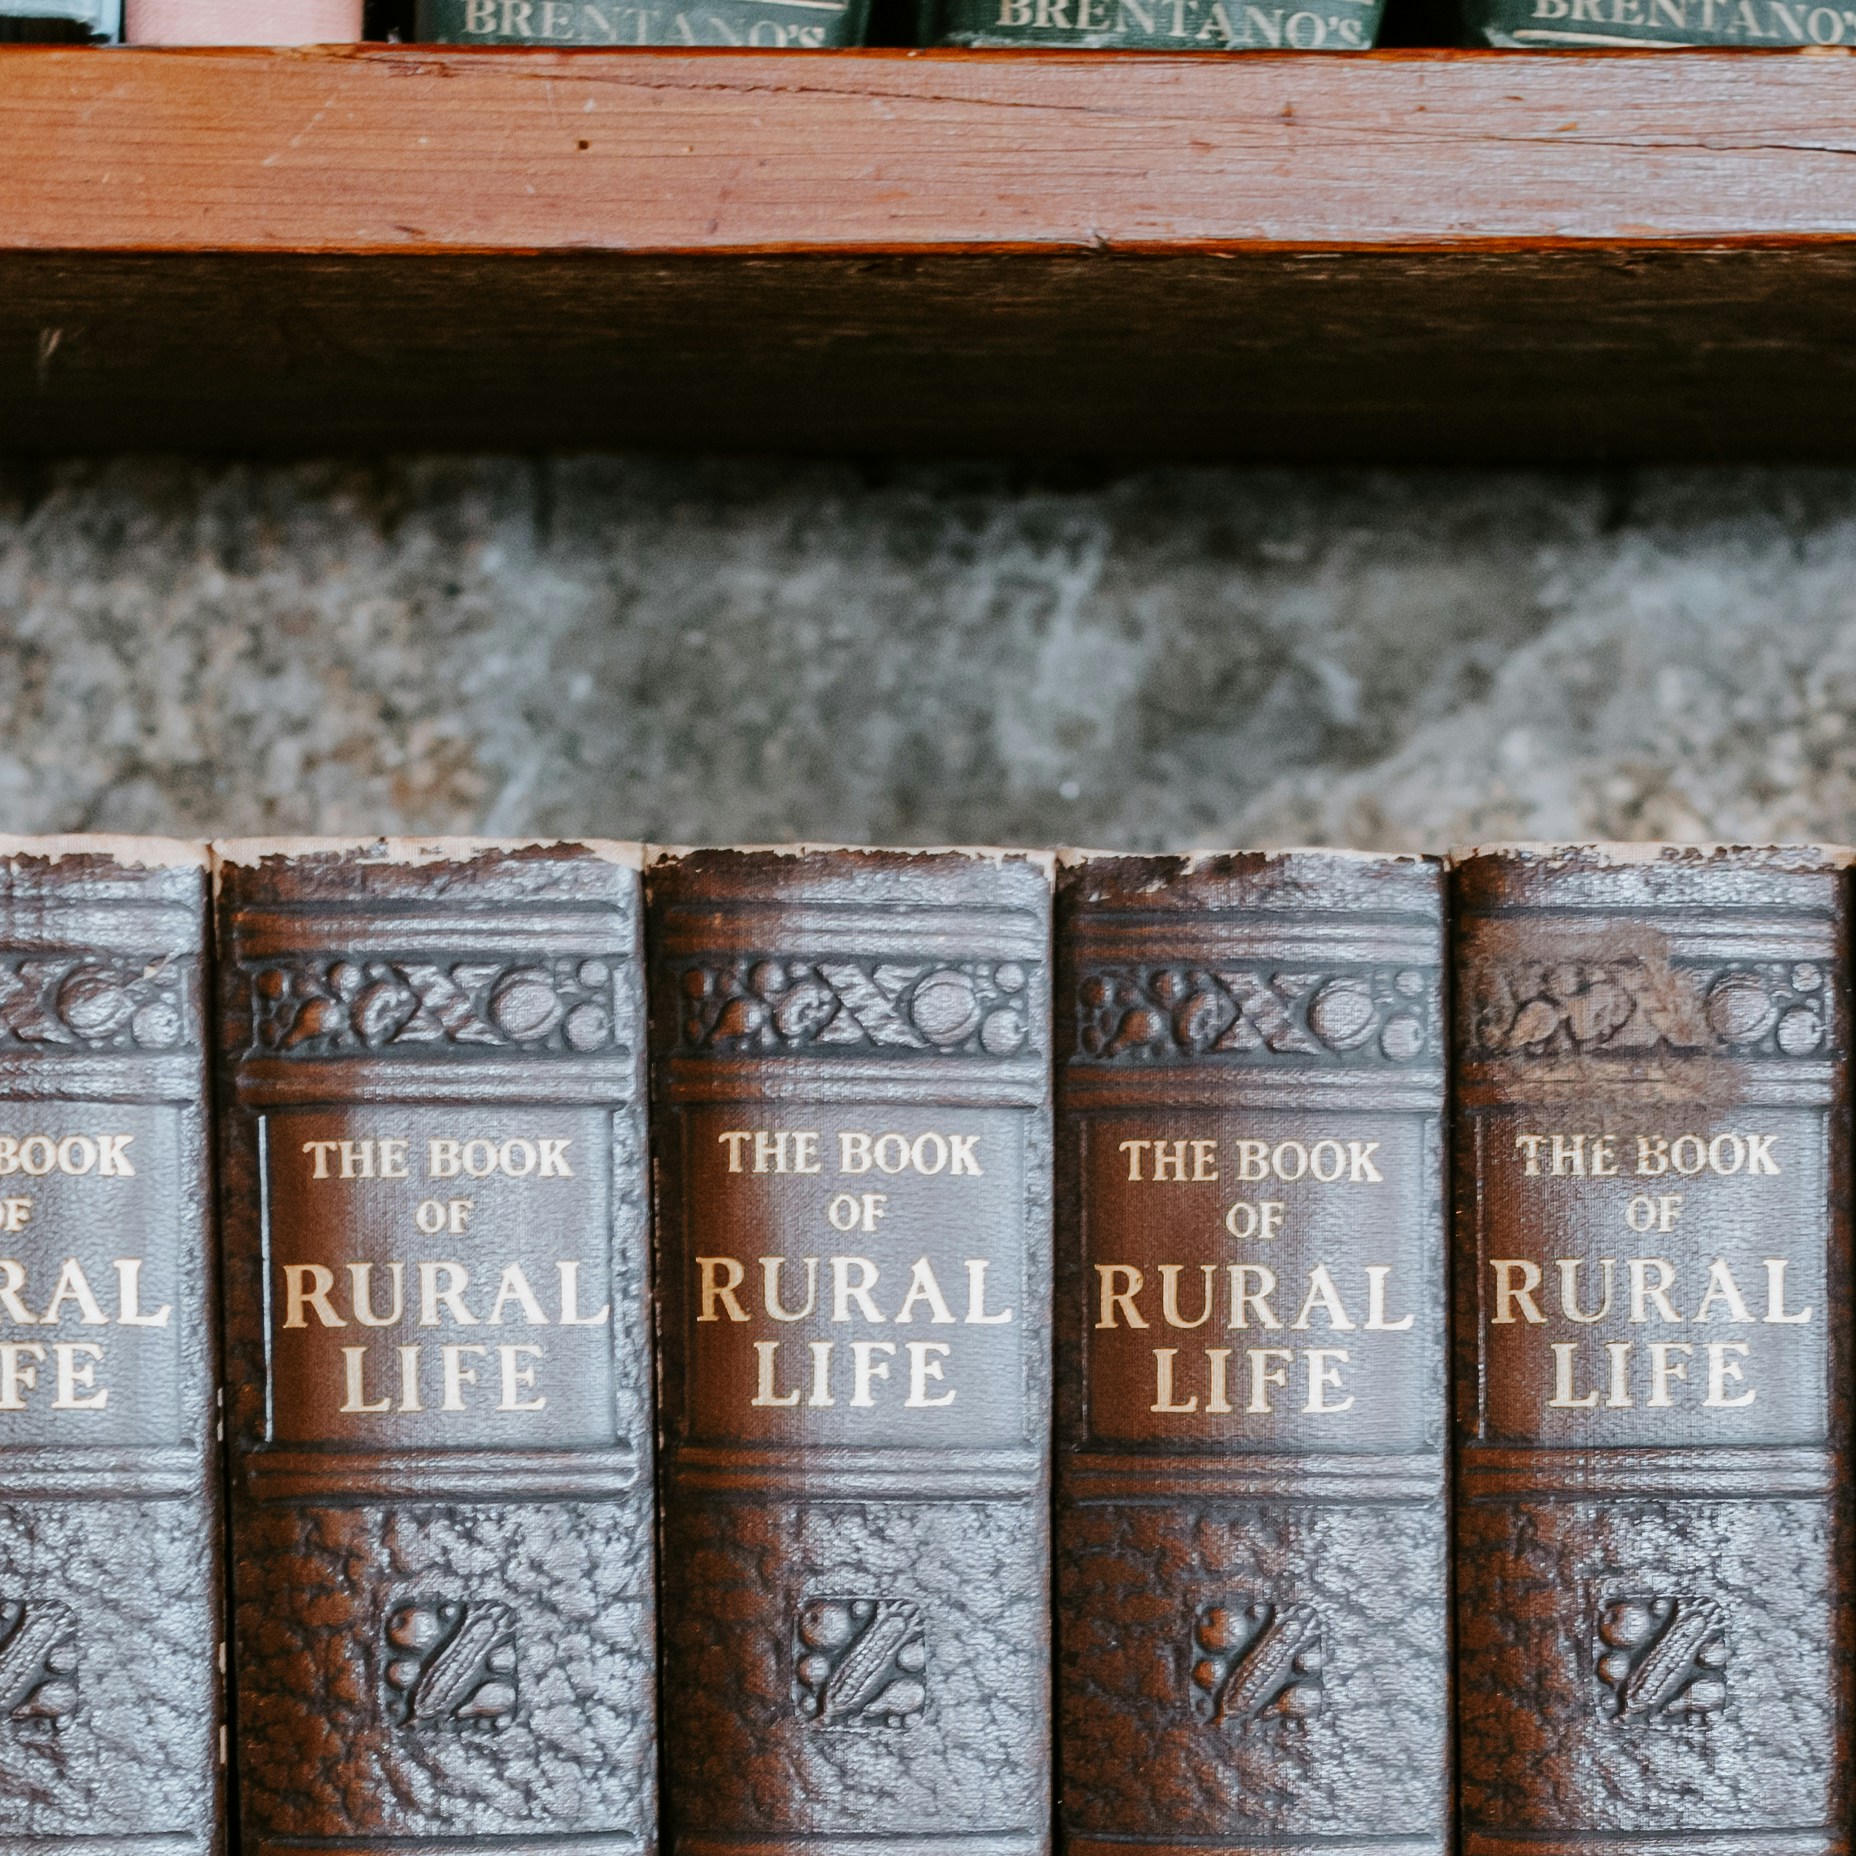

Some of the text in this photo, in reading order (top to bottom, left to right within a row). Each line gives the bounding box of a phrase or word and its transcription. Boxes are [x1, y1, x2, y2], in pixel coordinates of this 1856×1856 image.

[302, 1138, 573, 1179] THE BOOK
[718, 1131, 981, 1176] THE BOOK
[1119, 1140, 1384, 1183] THE BOOK
[1516, 1134, 1781, 1176] THE BOOK
[283, 1259, 610, 1329] RURAL
[696, 1257, 1013, 1325] RURAL
[1094, 1264, 1415, 1331] RURAL
[1489, 1258, 1813, 1325] RURAL
[339, 1345, 547, 1414] LIFE
[752, 1341, 957, 1409] LIFE
[1151, 1348, 1355, 1415] LIFE
[1549, 1342, 1757, 1409] LIFE
